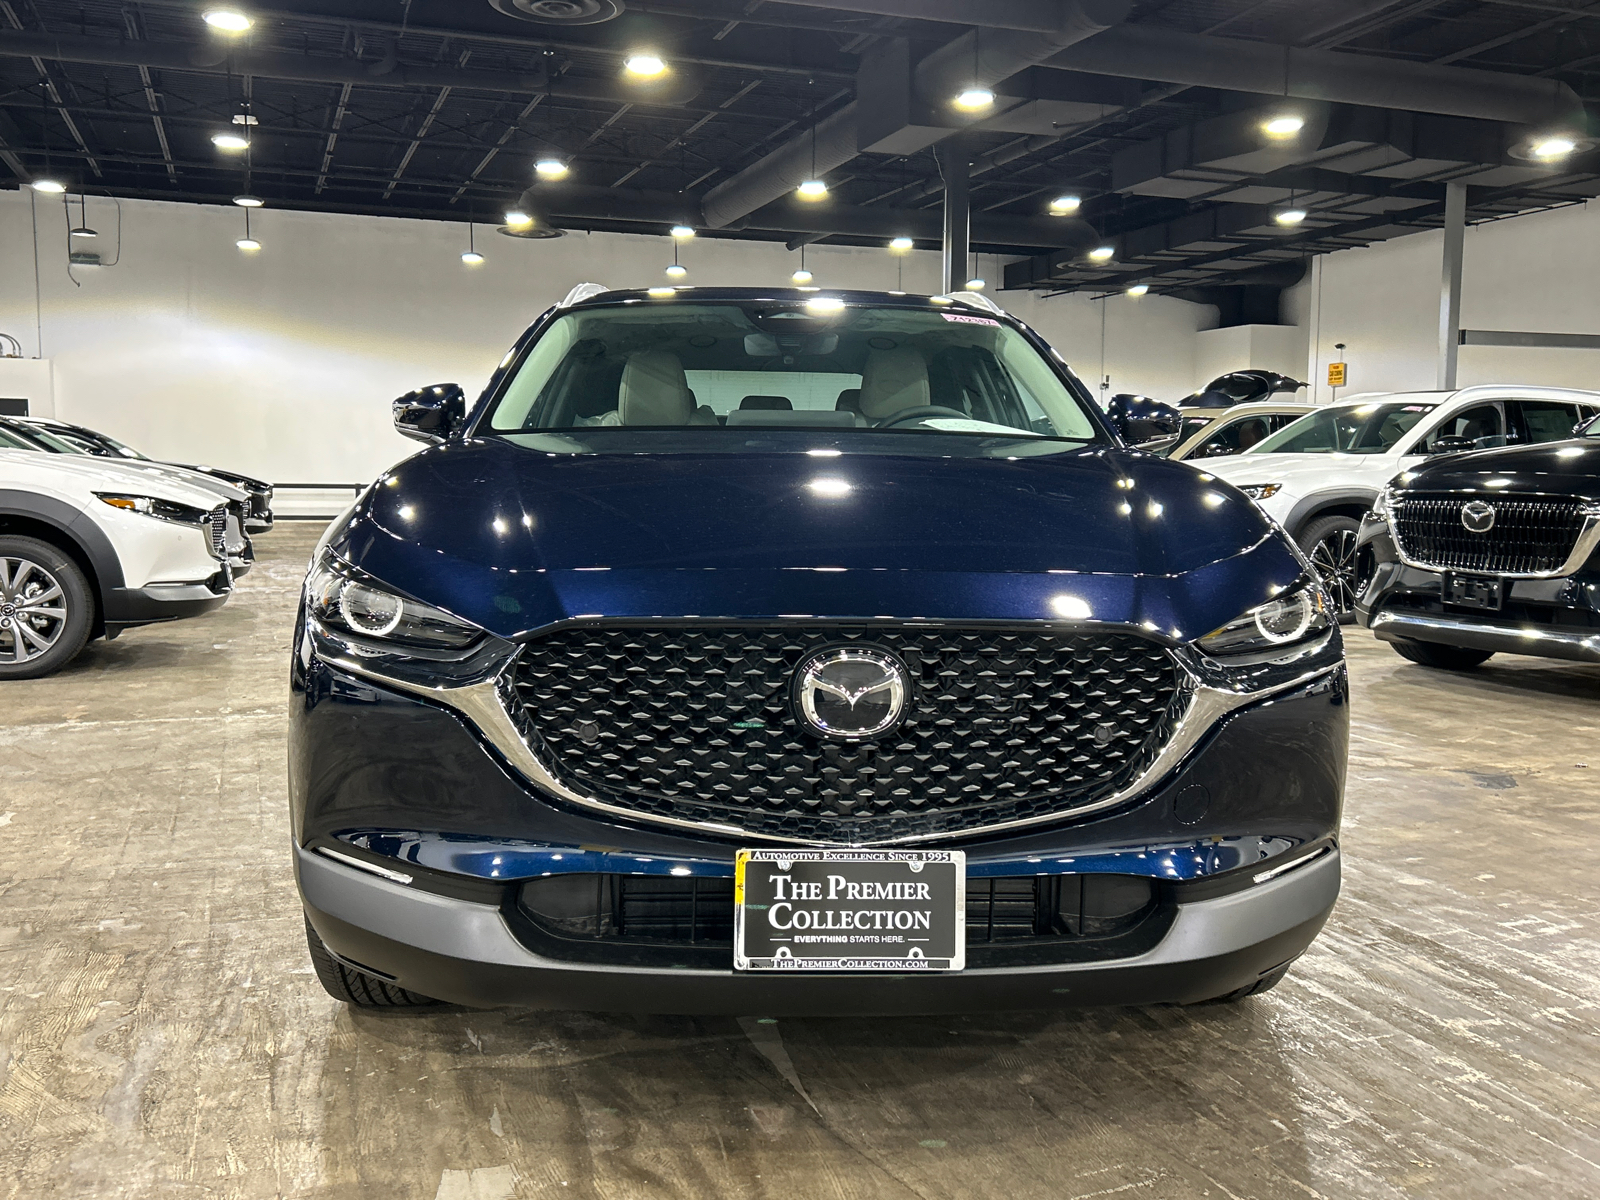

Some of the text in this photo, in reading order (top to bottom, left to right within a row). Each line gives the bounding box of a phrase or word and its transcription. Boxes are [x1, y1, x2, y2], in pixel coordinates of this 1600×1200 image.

[753, 850, 949, 862] AUTOMOTIVE EXCELLENCE SINCE 1995
[769, 874, 932, 900] THE PREMIER
[768, 902, 932, 930] COLLECTION
[794, 935, 906, 943] EVERYTHING STARTS HERE.
[770, 958, 929, 969] THEPREMIERCOLLECTION.COM
